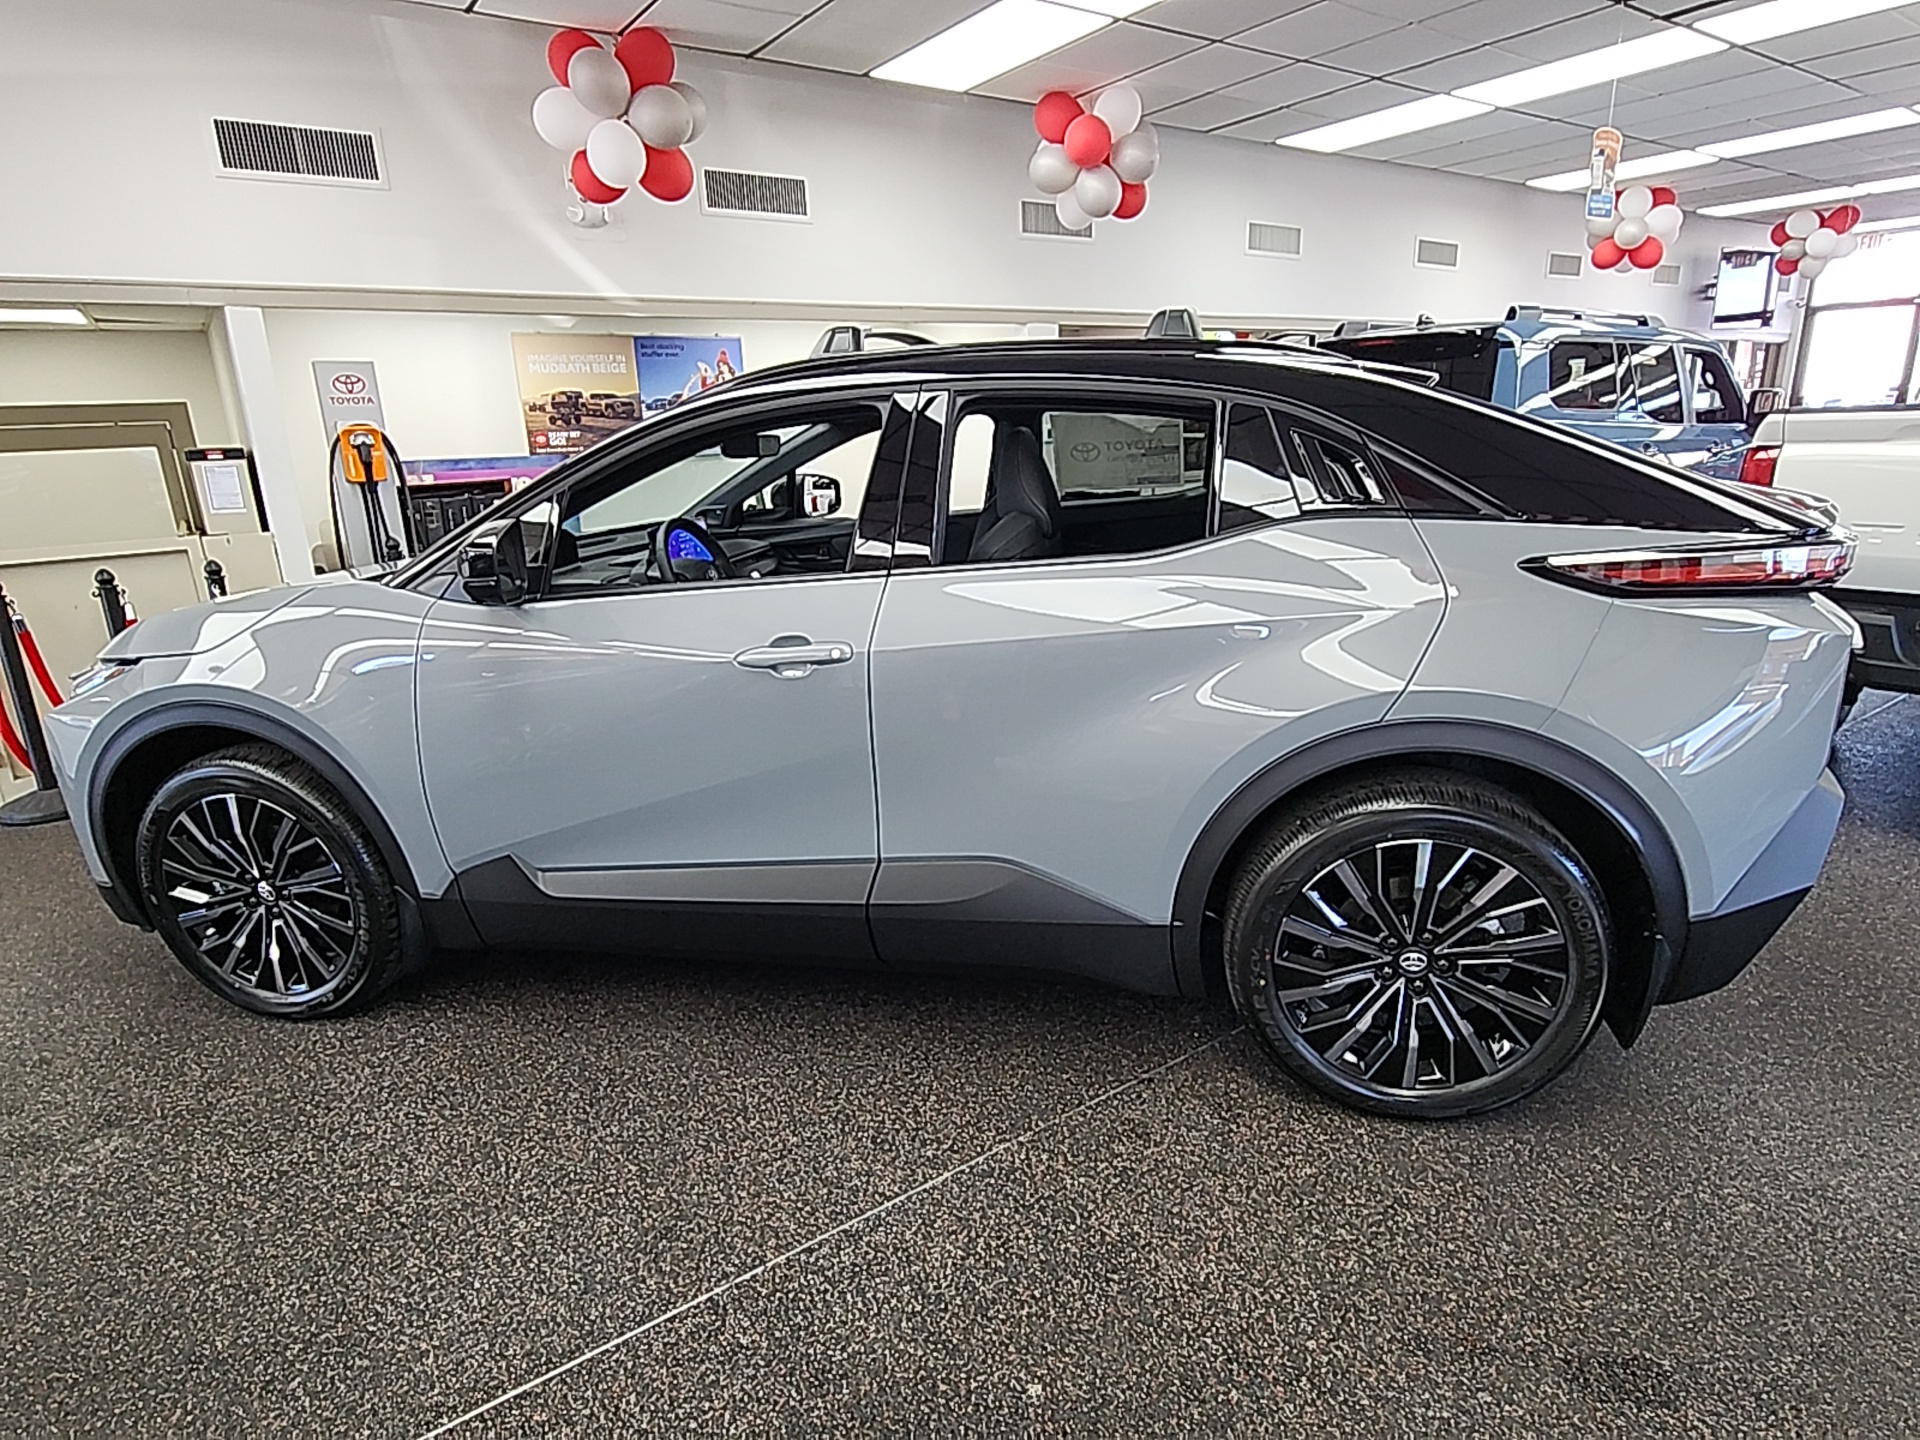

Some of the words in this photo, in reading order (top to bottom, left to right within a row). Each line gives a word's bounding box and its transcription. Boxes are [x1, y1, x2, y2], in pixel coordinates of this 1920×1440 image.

[527, 354, 568, 363] IMAGINE
[569, 354, 614, 363] YOURSELF
[615, 354, 626, 362] IN
[528, 363, 591, 374] MUDBATH
[592, 363, 627, 374] BEIGE
[329, 396, 375, 405] TOYOTA
[1104, 439, 1164, 451] TOYOTA
[1563, 887, 1599, 979] YOKOHAMA
